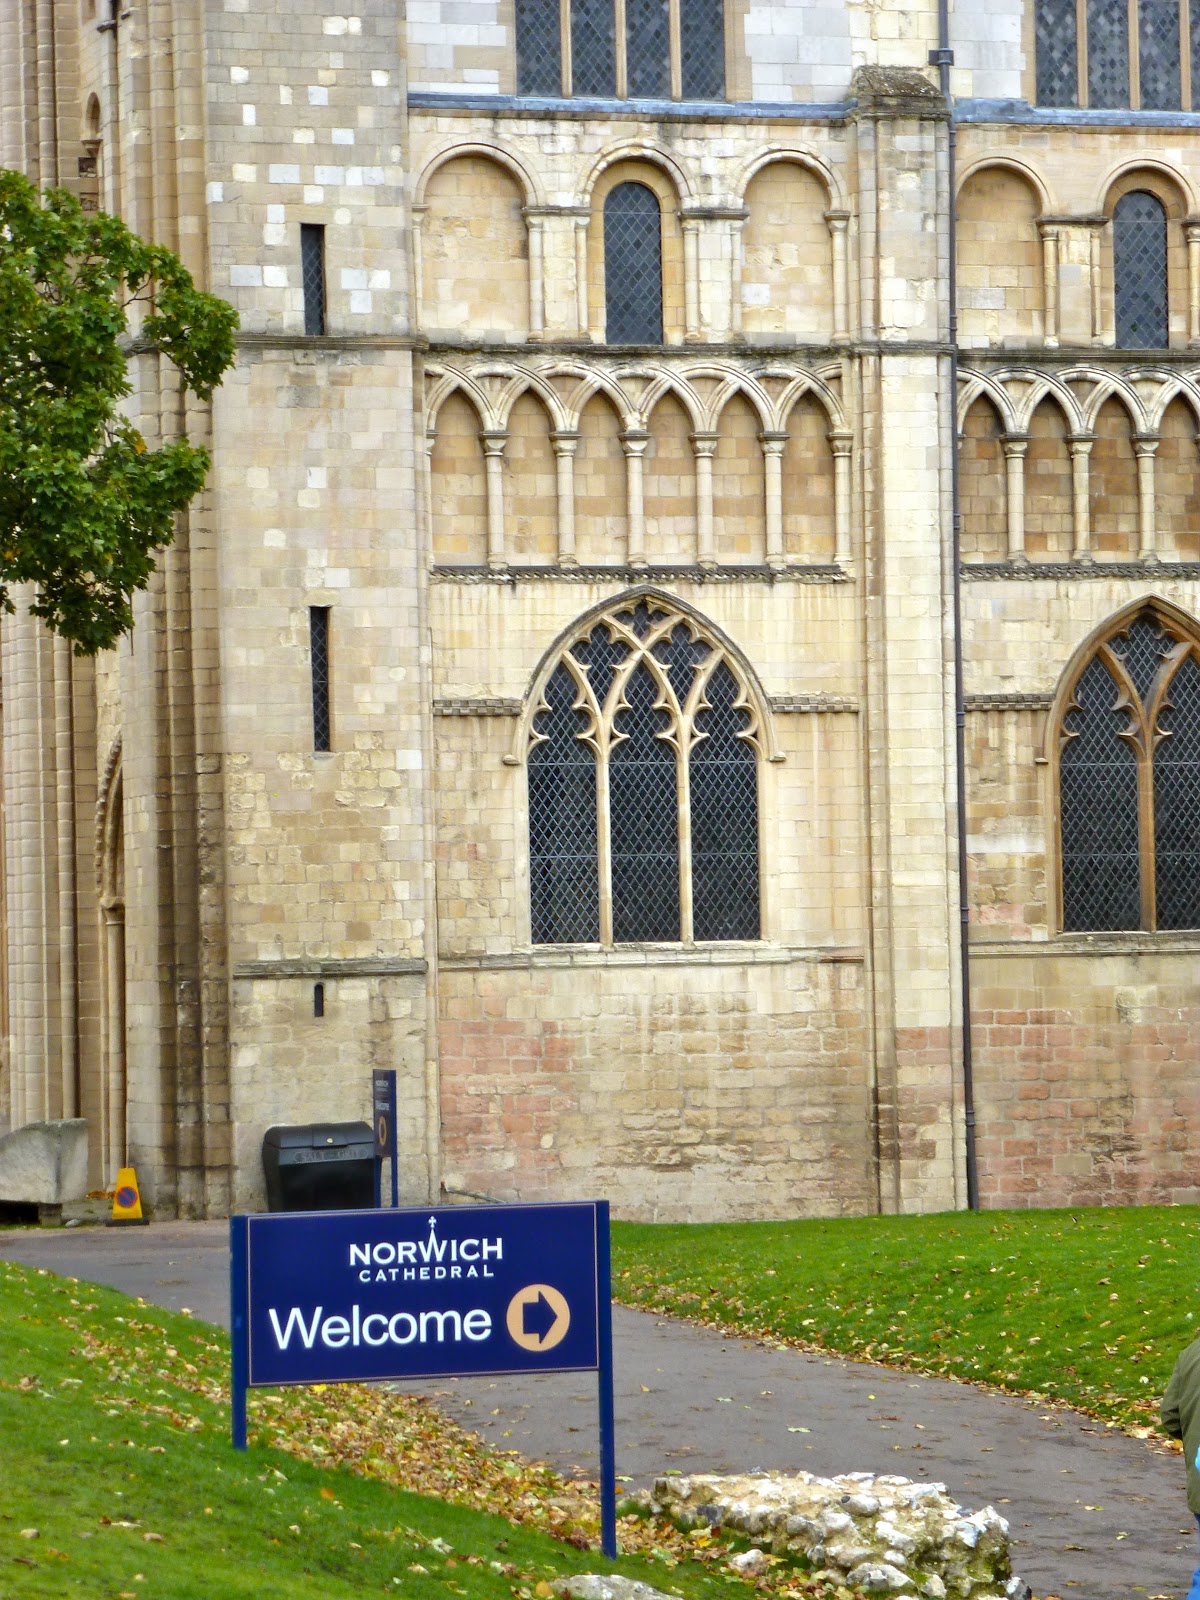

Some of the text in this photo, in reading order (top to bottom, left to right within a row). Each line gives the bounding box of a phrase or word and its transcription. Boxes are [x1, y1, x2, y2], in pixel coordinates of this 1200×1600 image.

[349, 1229, 503, 1266] NORWICH
[358, 1264, 495, 1283] CATHEDRAL
[268, 1304, 492, 1350] Welcome
